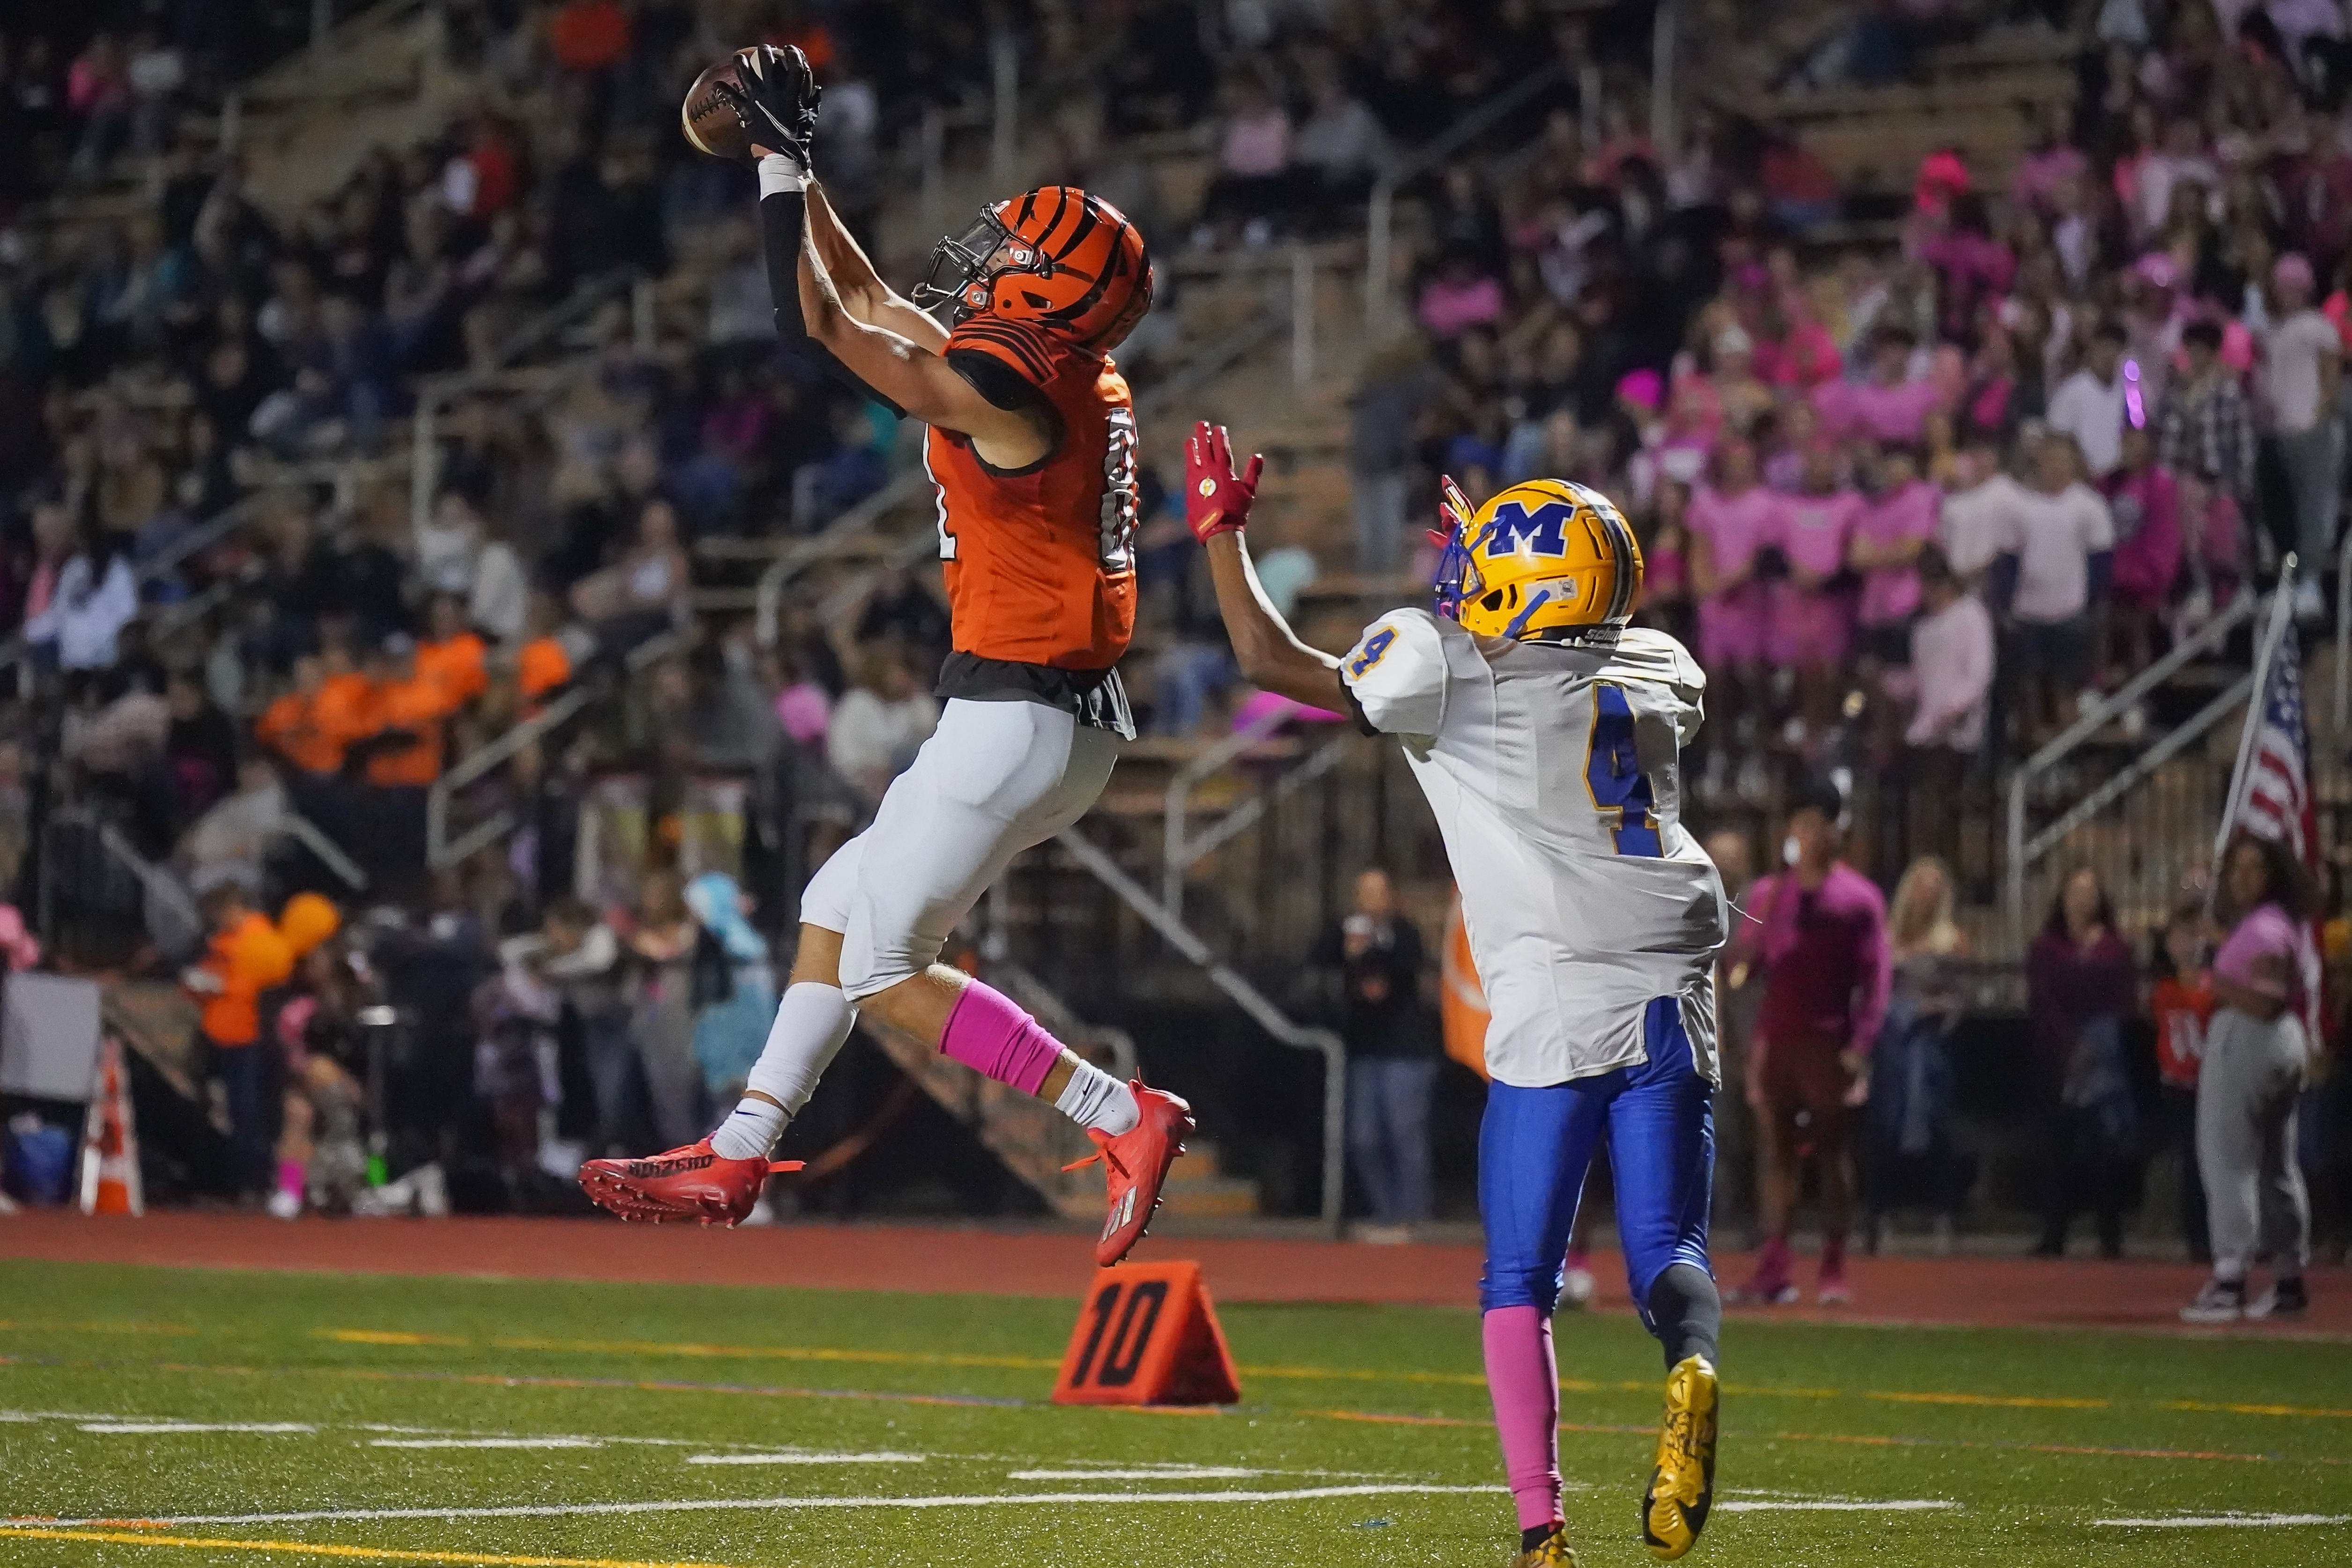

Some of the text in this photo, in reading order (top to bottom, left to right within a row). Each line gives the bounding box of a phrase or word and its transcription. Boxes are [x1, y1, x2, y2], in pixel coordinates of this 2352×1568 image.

[1485, 500, 1578, 559] M
[1348, 625, 1400, 681] 4
[1582, 680, 1665, 858] 4
[1071, 1282, 1169, 1388] 10
